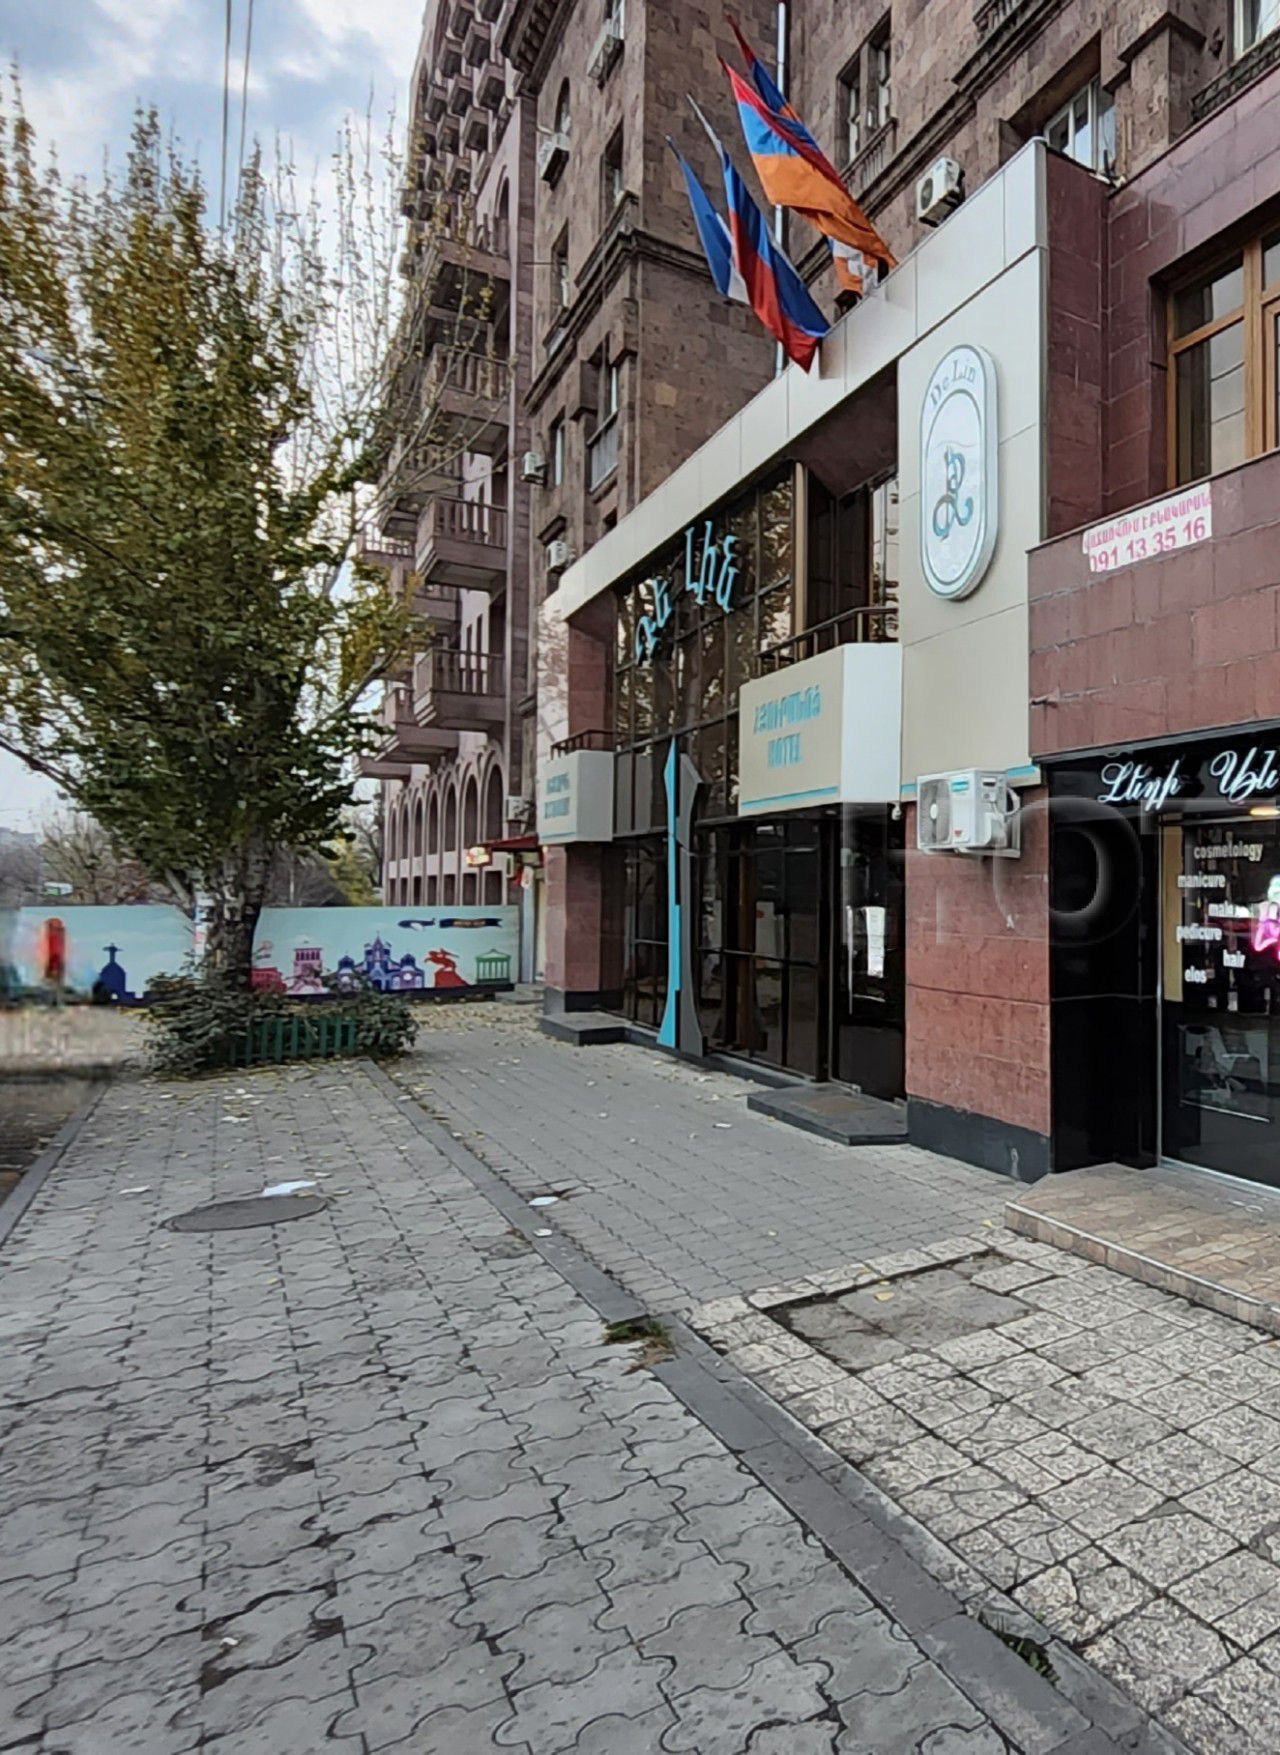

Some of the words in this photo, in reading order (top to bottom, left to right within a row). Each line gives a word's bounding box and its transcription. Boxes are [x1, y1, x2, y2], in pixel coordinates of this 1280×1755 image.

[1126, 538, 1147, 559] 13
[1153, 526, 1177, 552] 35
[1182, 516, 1206, 542] 16
[1193, 841, 1263, 861] cosmetology
[1177, 873, 1226, 888] manicure
[1223, 949, 1245, 968] hair
[1185, 965, 1207, 983] elos
